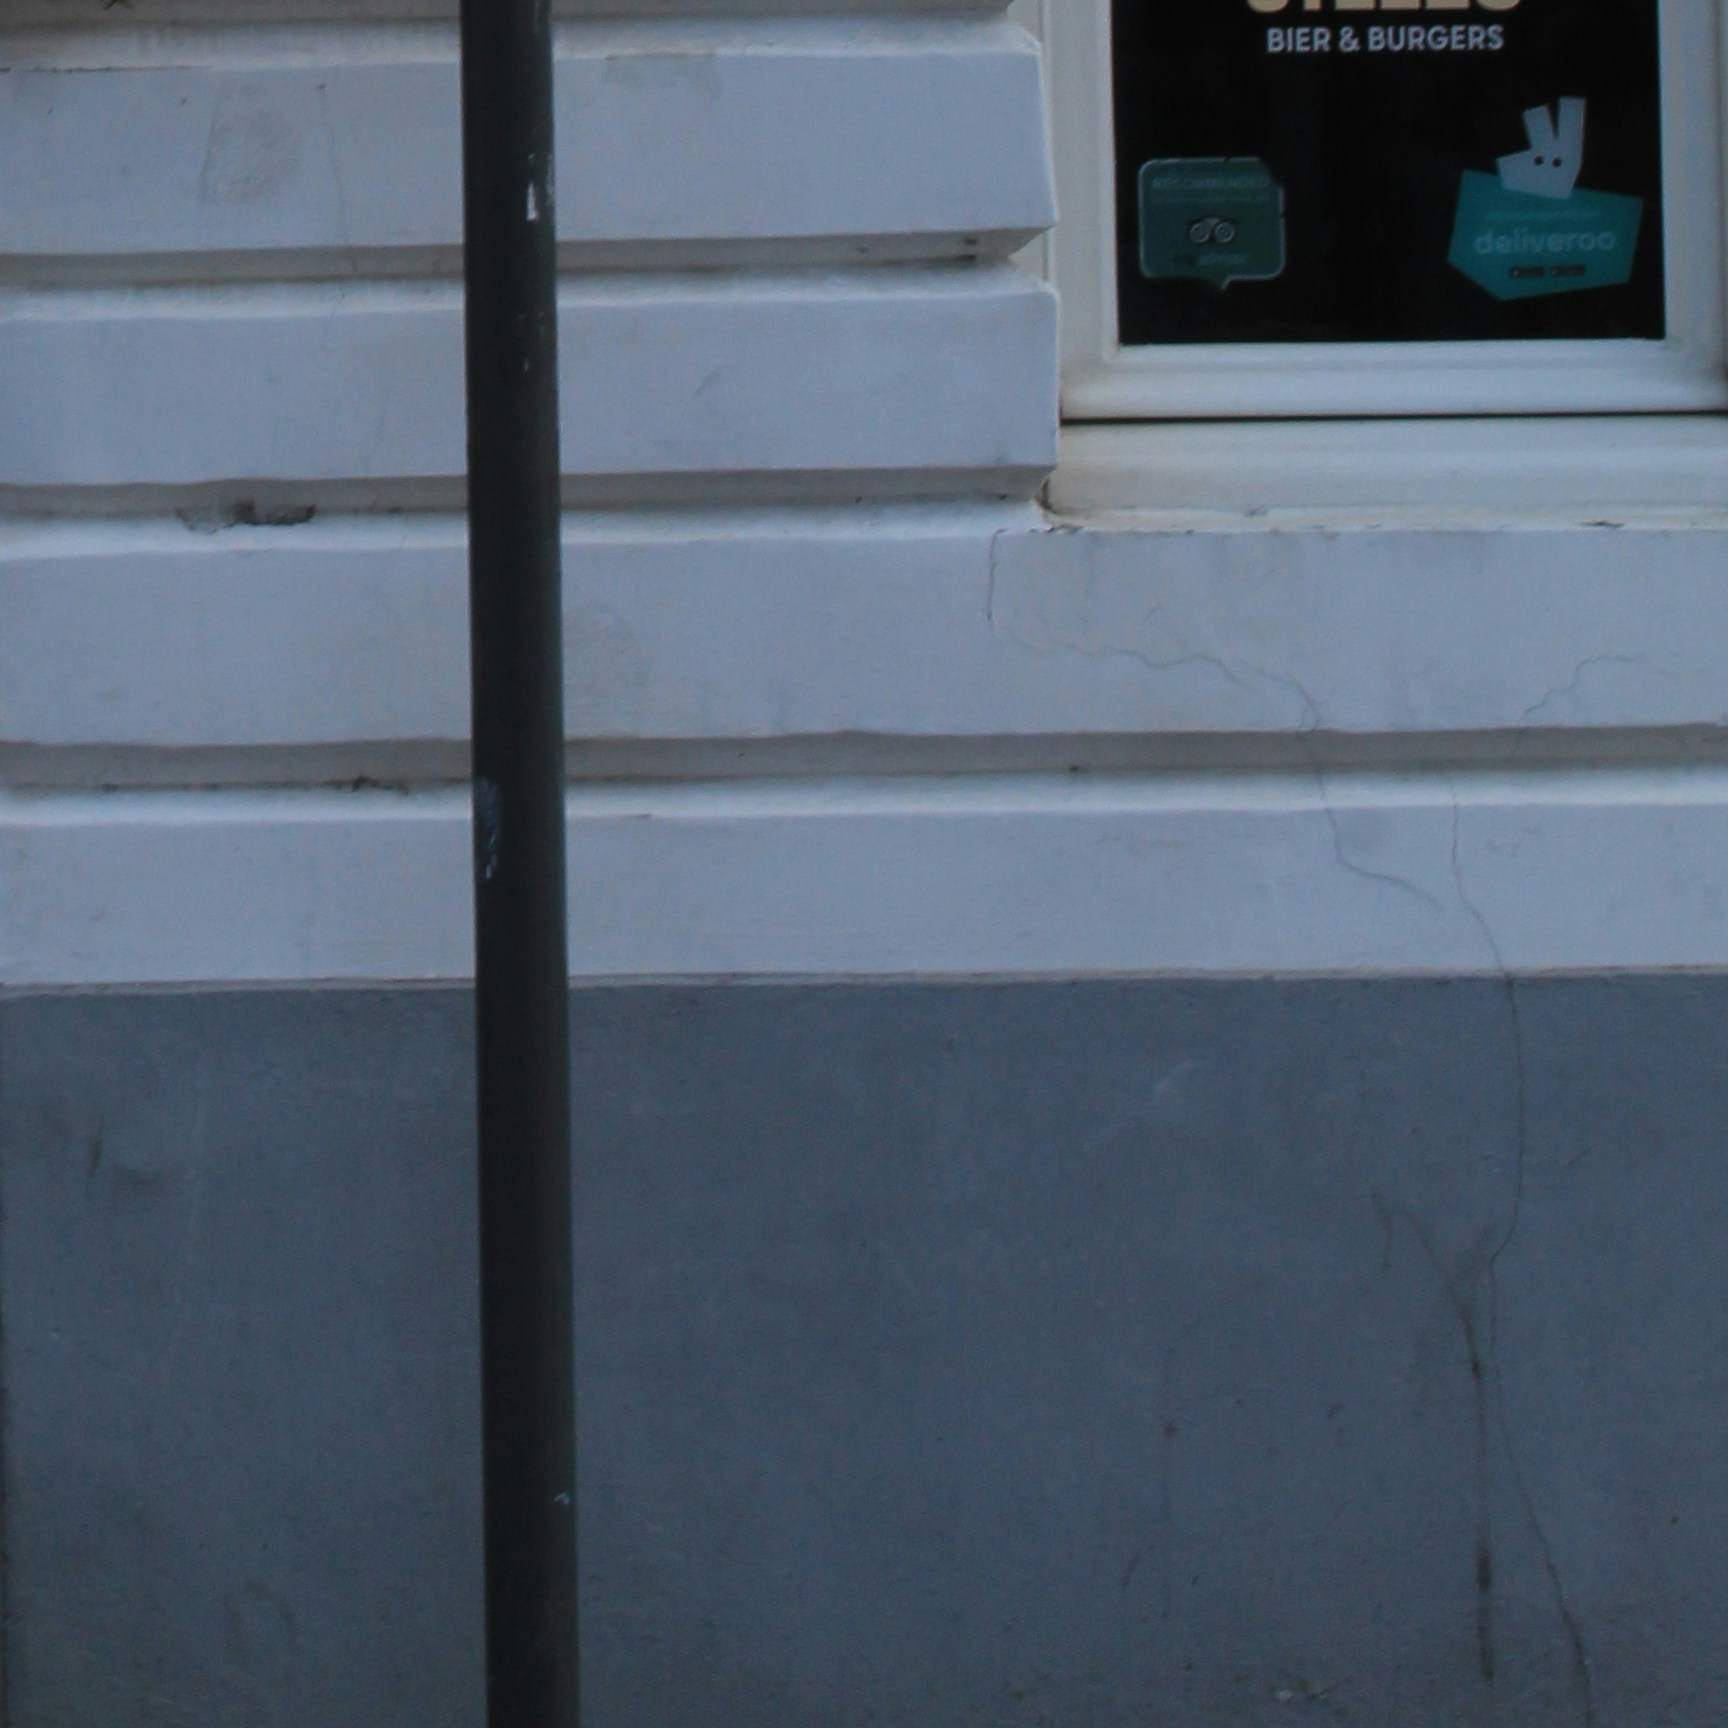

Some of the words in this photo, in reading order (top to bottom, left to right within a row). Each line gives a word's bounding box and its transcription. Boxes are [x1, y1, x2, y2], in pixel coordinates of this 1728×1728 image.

[1266, 26, 1331, 53] BIER
[1339, 26, 1361, 52] &
[1368, 24, 1505, 52] BURGERS
[1472, 226, 1618, 255] deliveroo
